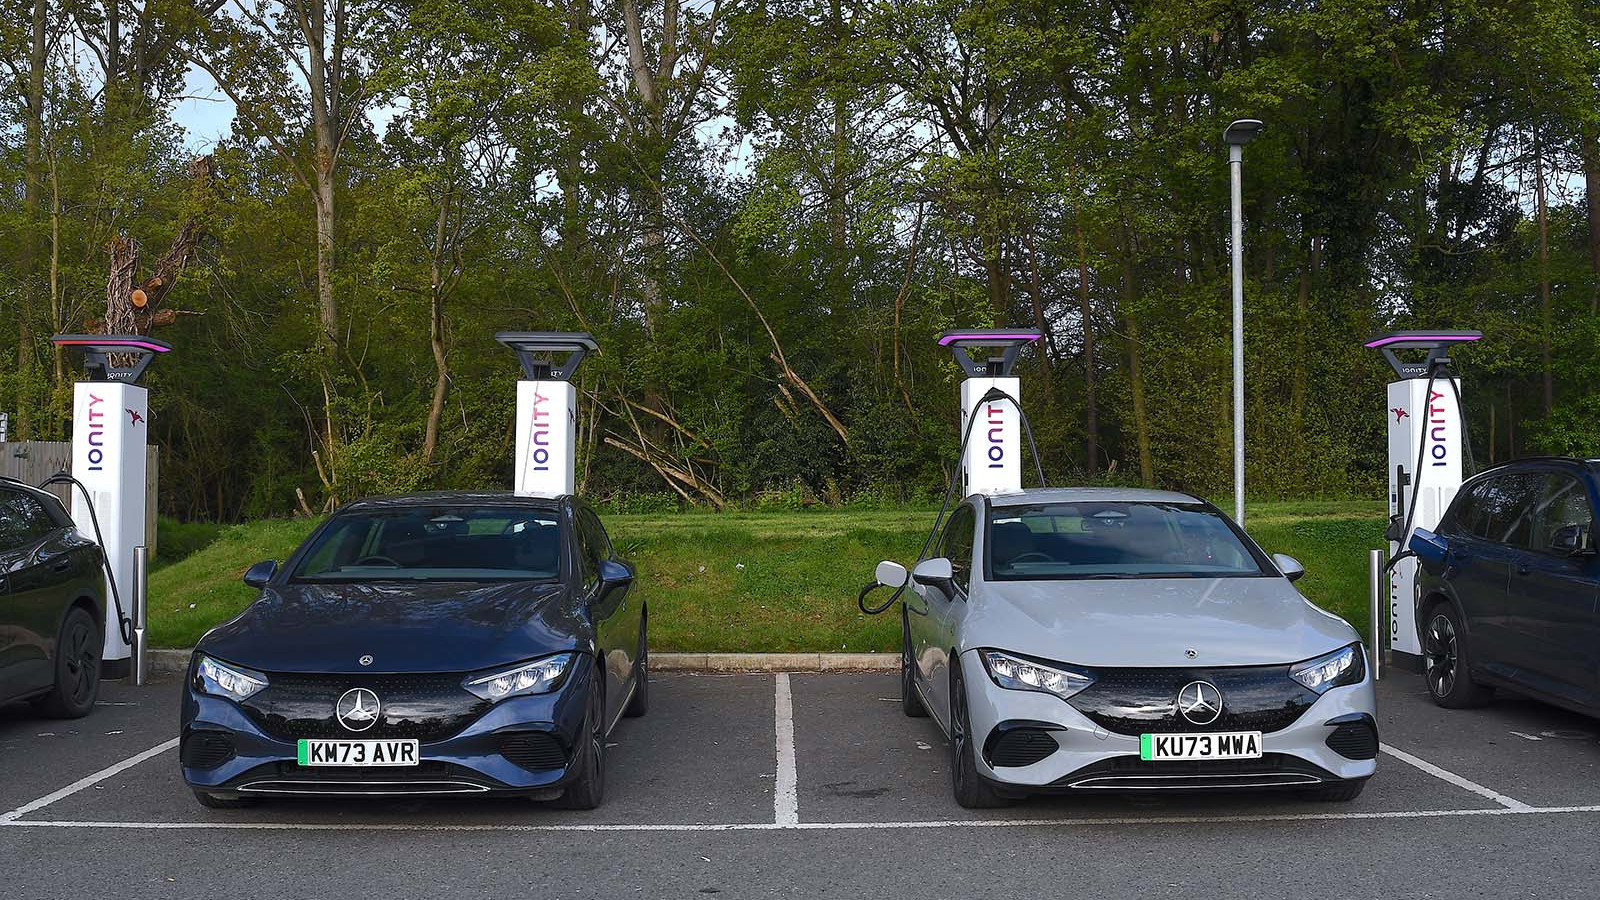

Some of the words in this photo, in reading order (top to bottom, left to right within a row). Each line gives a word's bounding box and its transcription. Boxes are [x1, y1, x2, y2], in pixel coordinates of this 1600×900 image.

[88, 393, 104, 471] IONITY
[533, 392, 549, 471] IONITY
[988, 404, 1004, 468] IONIT
[1430, 390, 1447, 467] IONITY
[311, 743, 366, 763] KM73
[372, 743, 414, 762] AVR
[1156, 736, 1212, 757] KU73
[1218, 735, 1257, 755] MWA
